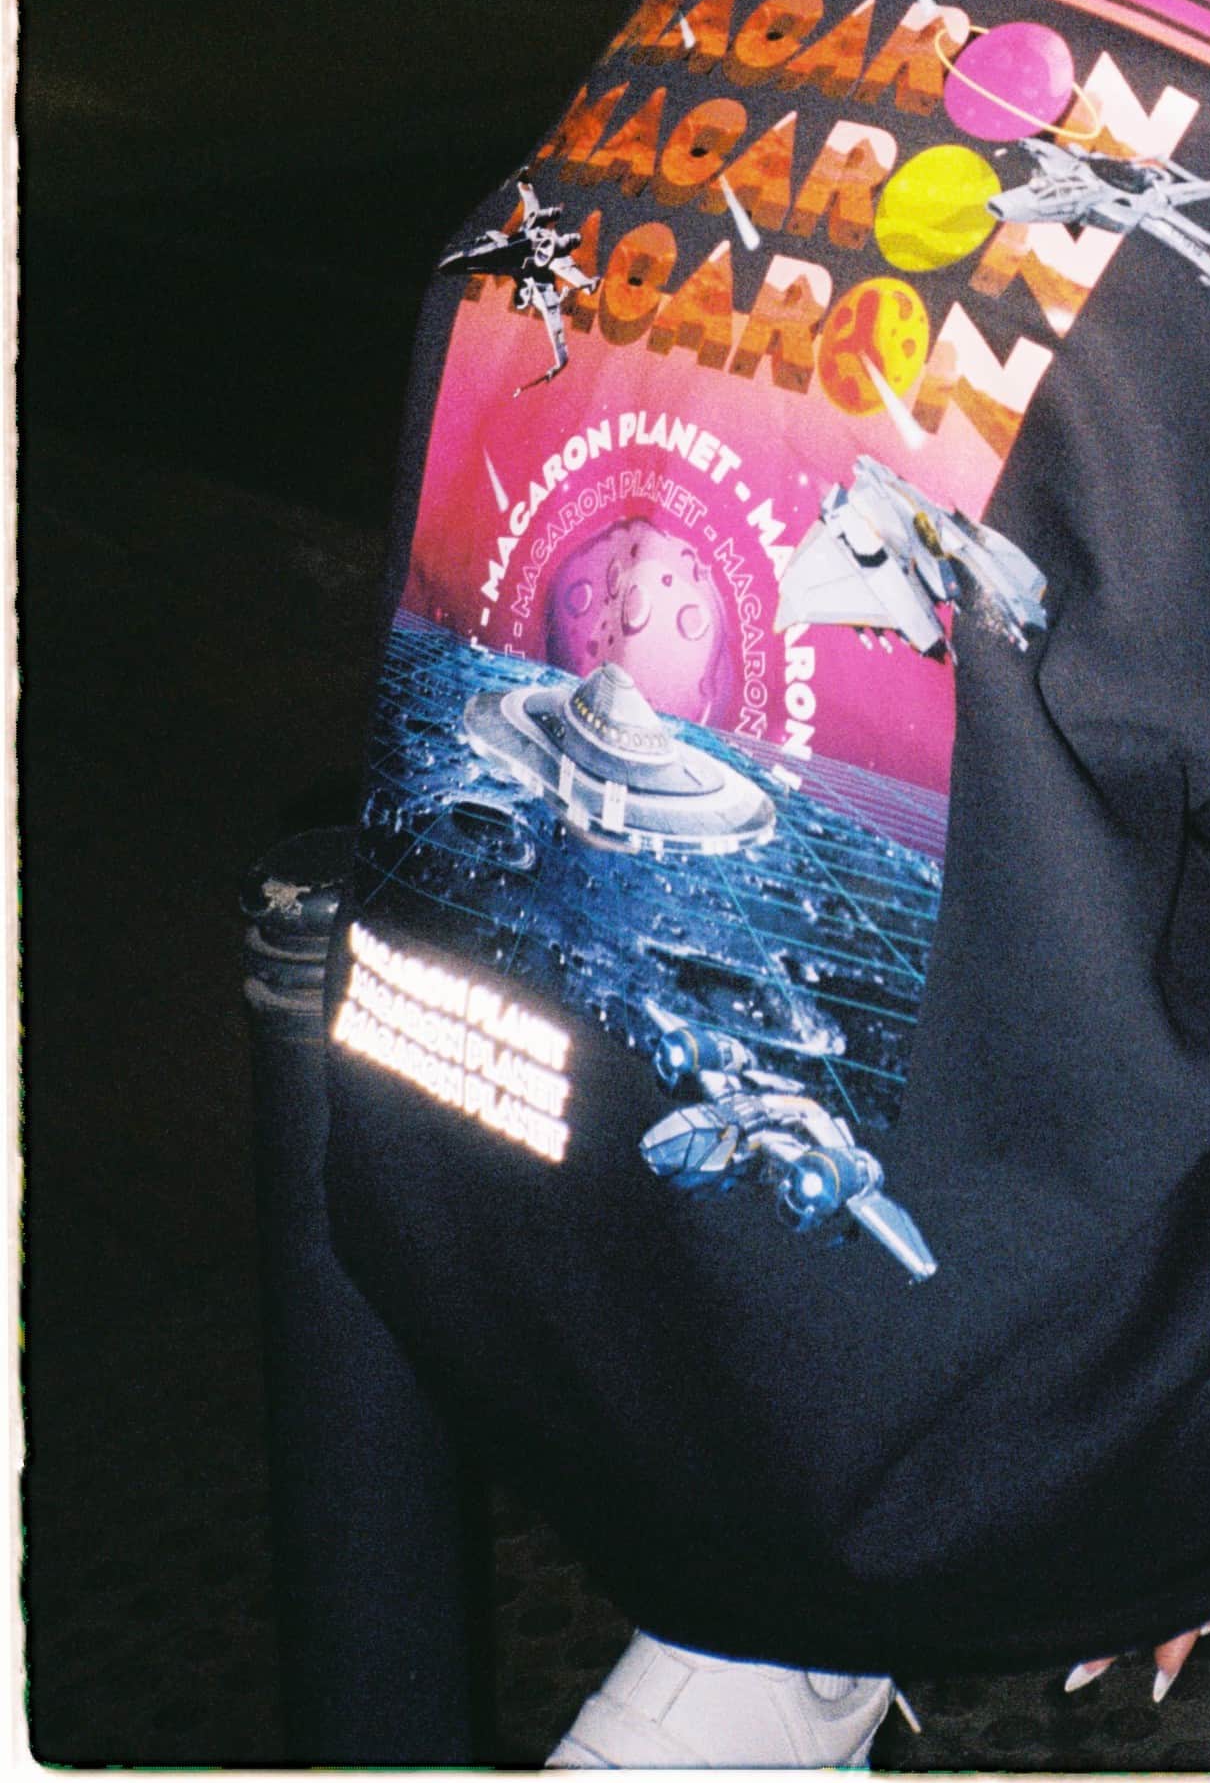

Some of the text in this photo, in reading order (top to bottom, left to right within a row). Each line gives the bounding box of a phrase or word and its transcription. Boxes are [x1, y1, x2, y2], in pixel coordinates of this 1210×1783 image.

[480, 420, 612, 603] MACARON
[619, 411, 742, 484] PLANET
[510, 477, 616, 618] MACARON
[619, 470, 708, 528] PLANET
[714, 537, 768, 741] MACARON
